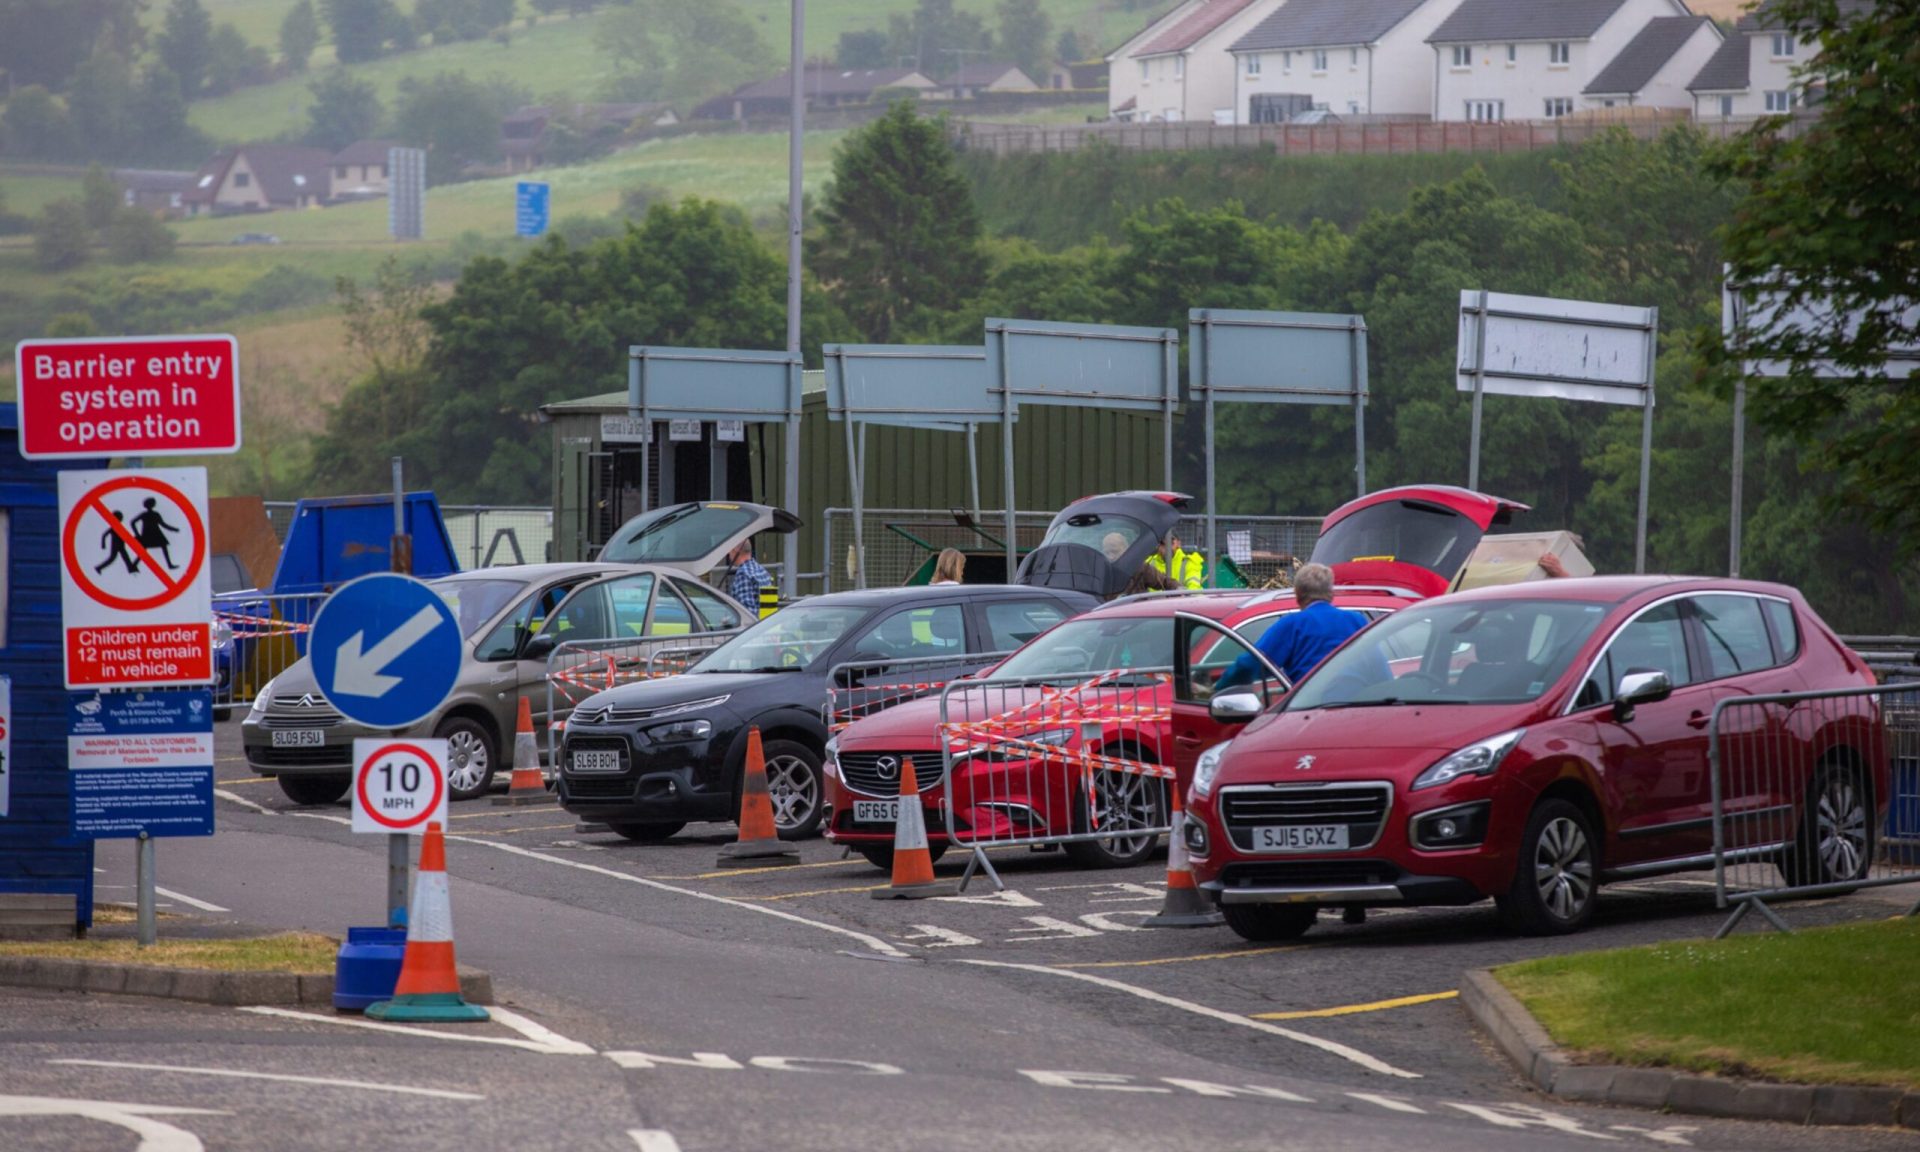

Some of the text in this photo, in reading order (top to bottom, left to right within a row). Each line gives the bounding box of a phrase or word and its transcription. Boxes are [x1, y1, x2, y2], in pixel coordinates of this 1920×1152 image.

[34, 351, 222, 380] Barrier entry
[59, 382, 197, 414] system in
[59, 414, 200, 444] operation
[79, 628, 198, 646] Children under
[77, 644, 202, 662] 12 must remain
[101, 662, 178, 677] in vehicle
[275, 731, 320, 745] SL09 FSU
[576, 753, 617, 768] SL68 BOH
[378, 762, 421, 793] 10
[382, 797, 415, 809] MPH
[858, 803, 899, 819] GF65 G
[1263, 827, 1337, 847] SJ15 GXZ
[602, 1050, 905, 1075] NO
[1016, 1069, 1699, 1146] ENTRY
